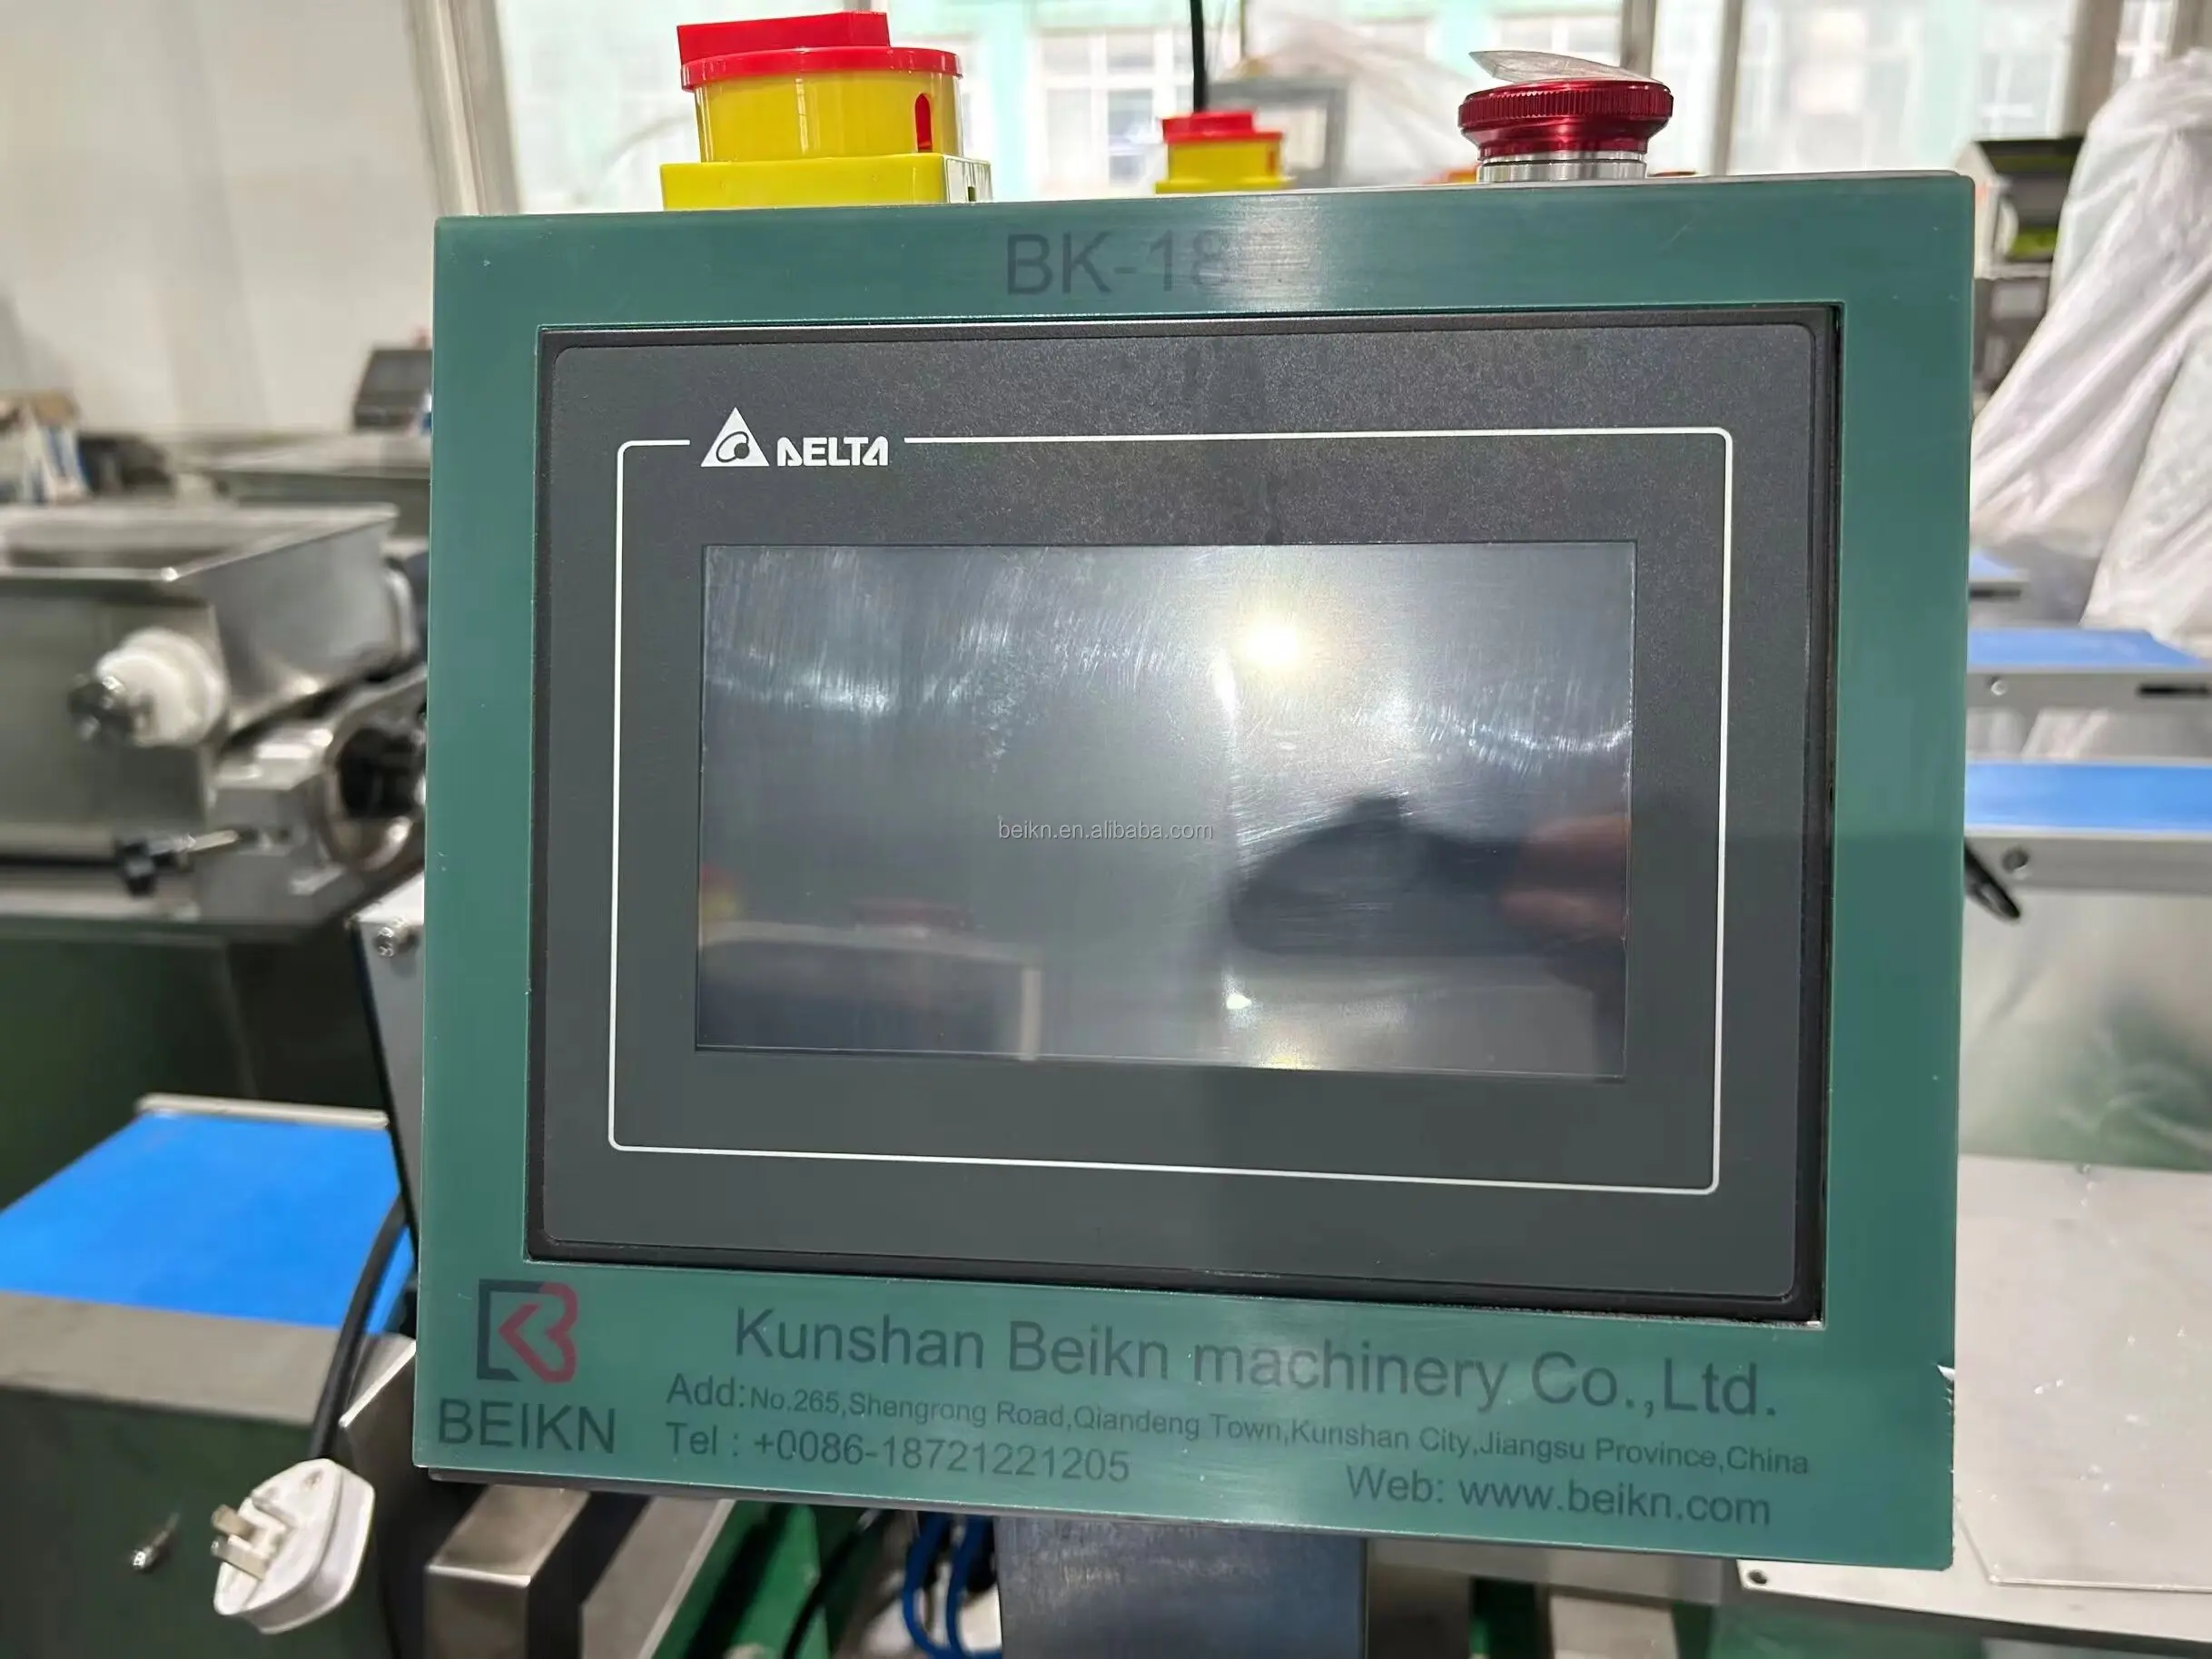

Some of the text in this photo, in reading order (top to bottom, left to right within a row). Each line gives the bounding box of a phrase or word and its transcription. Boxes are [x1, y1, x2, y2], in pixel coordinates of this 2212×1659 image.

[776, 436, 889, 467] DELTA
[735, 1306, 1777, 1418] Kunshan Beikn machinery Co.,Ltd.
[439, 1397, 616, 1454] BEIKN
[997, 1401, 1200, 1442] Road,Qiandeng
[1210, 1412, 1409, 1451] Town,Kunshan
[1419, 1426, 1585, 1465] City,Jiangsu
[1595, 1437, 1809, 1475] Province,China
[754, 1428, 1130, 1483] +0086-18721221205
[1347, 1464, 1772, 1526] Web: www.beikn.com
